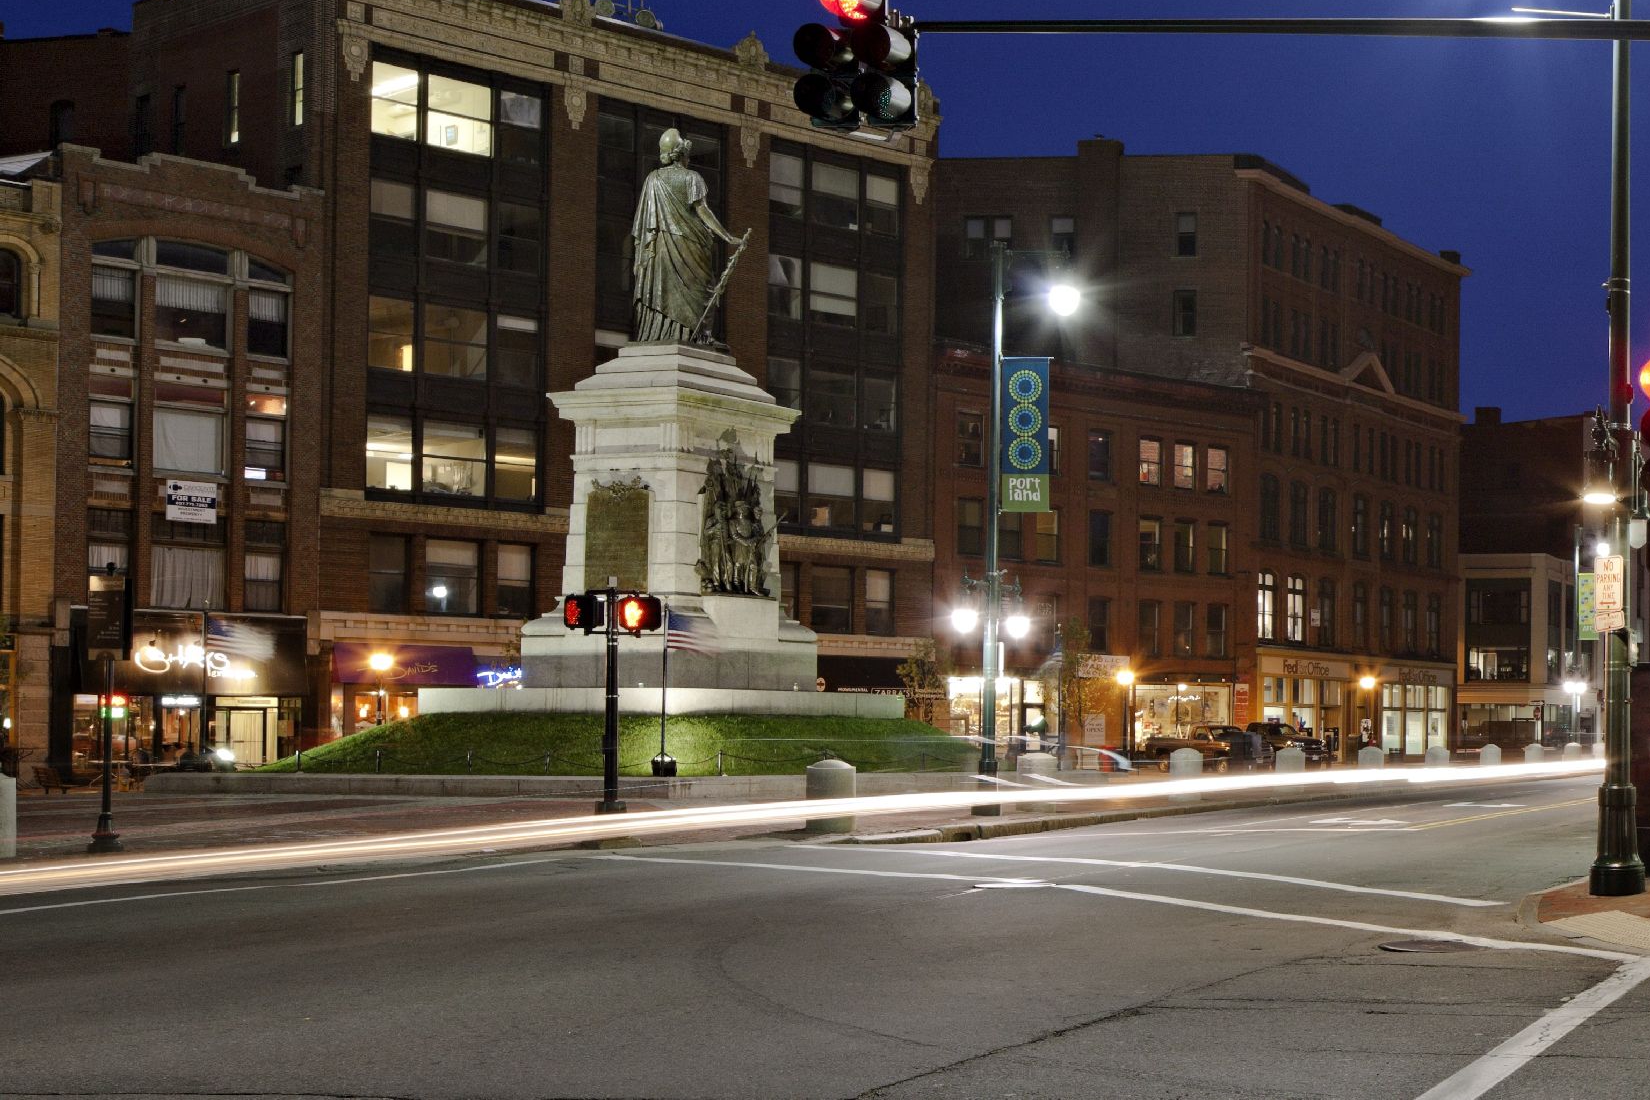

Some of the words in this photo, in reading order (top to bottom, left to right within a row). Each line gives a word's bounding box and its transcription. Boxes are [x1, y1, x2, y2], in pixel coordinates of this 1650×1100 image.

[1008, 477, 1041, 490] port
[171, 494, 189, 502] FOR
[191, 496, 212, 504] SALE
[1008, 488, 1041, 502] land
[1603, 561, 1614, 571] NO
[1596, 573, 1620, 584] PARKING
